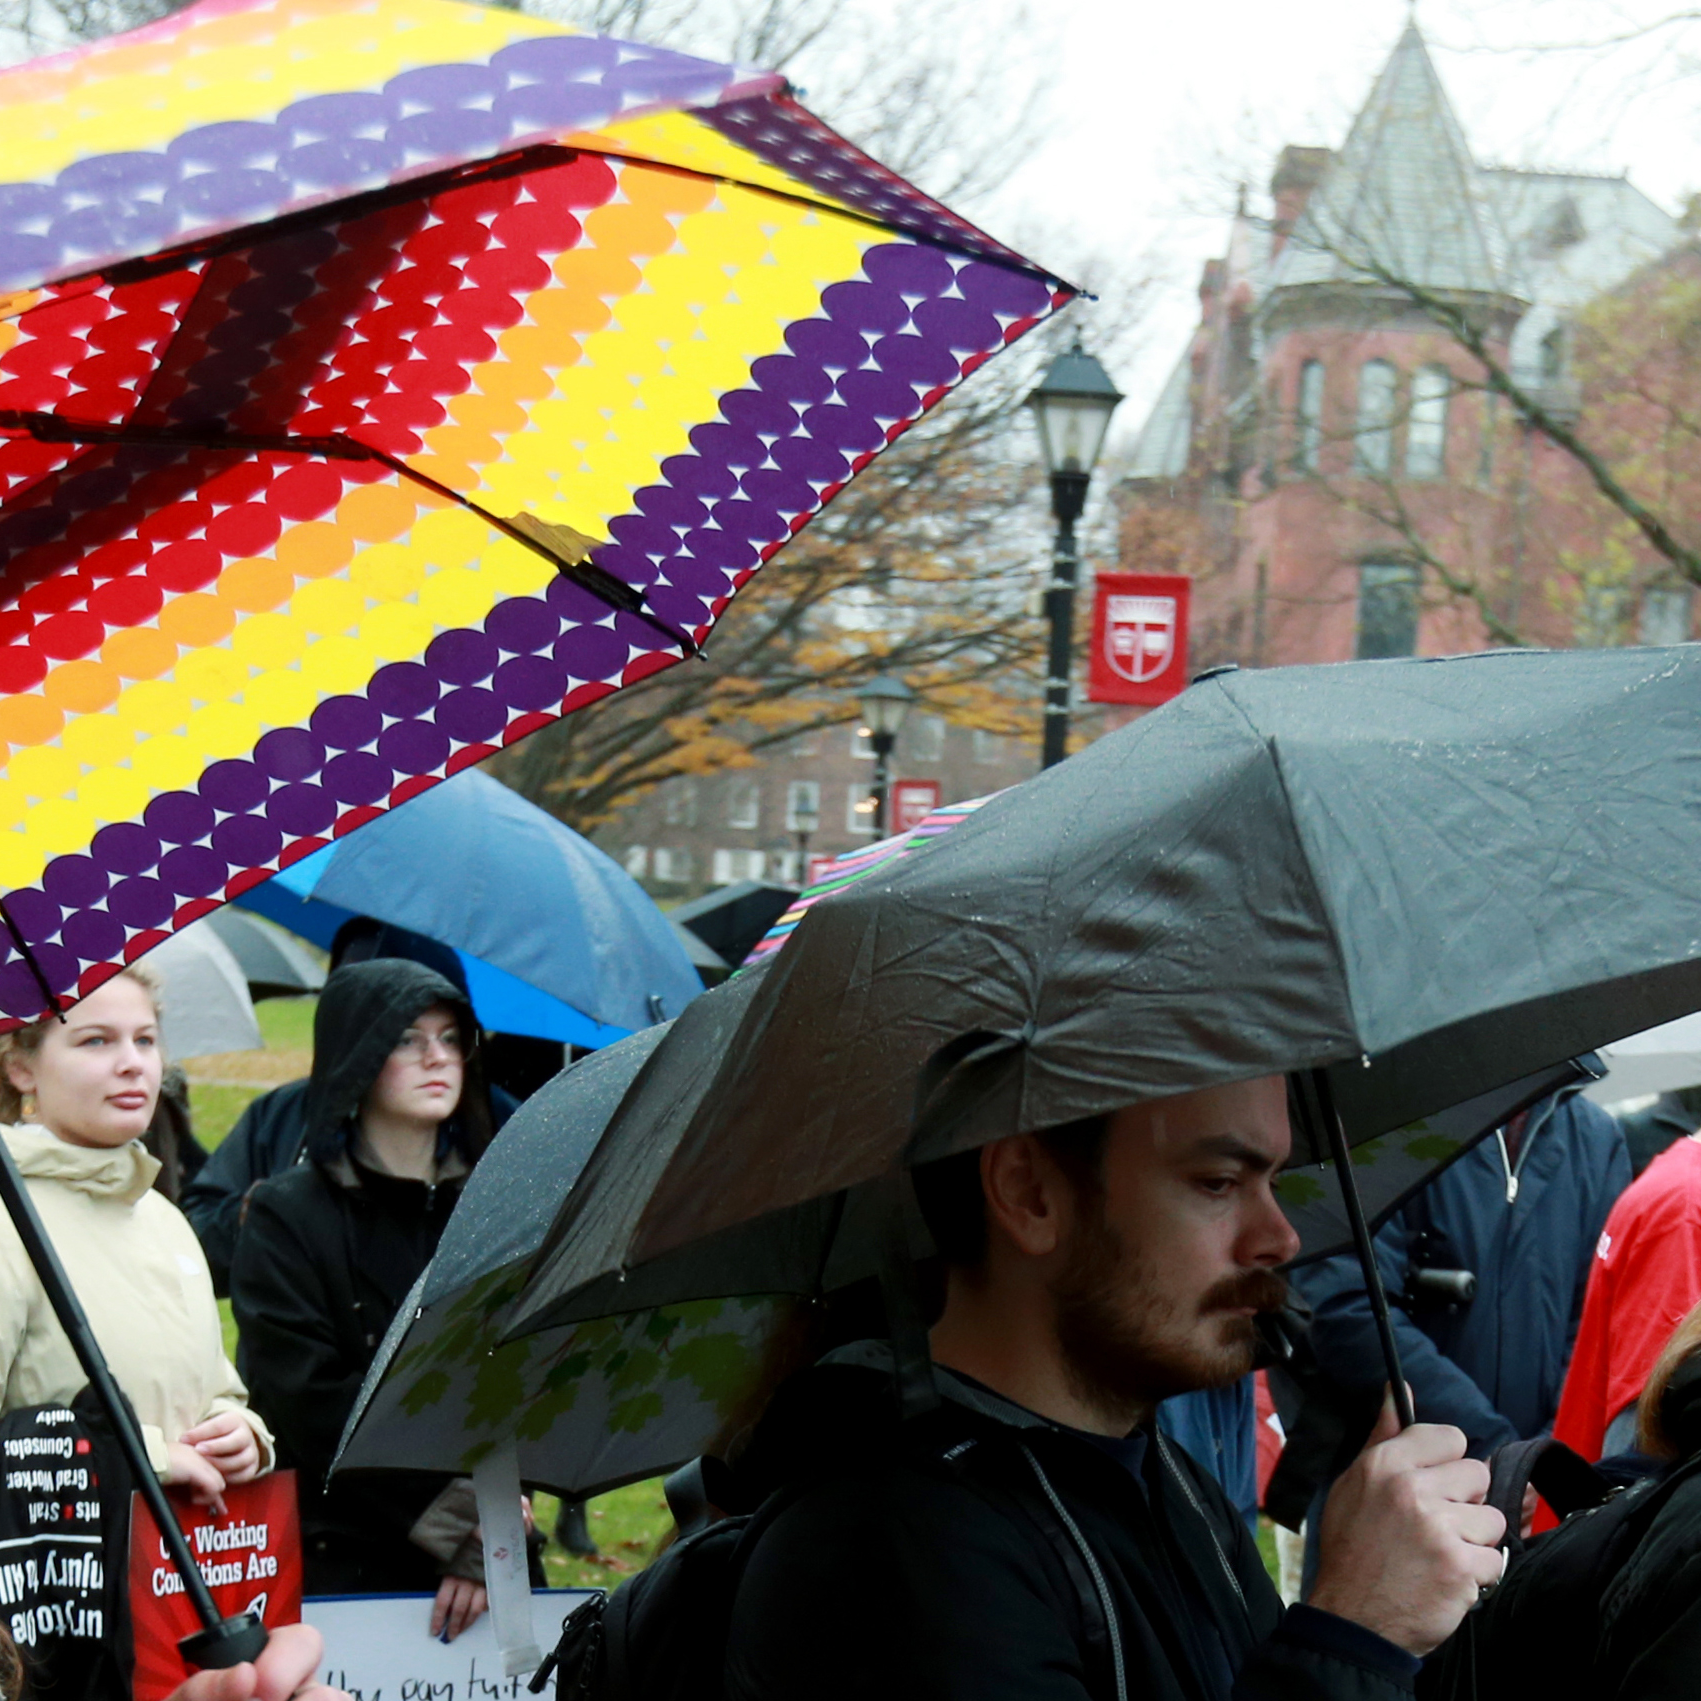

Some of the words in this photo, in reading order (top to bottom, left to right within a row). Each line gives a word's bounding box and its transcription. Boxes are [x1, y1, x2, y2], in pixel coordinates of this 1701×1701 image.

[56, 1468, 89, 1491] Grad
[194, 1520, 268, 1554] Working
[152, 1558, 243, 1597] Contions
[245, 1552, 278, 1580] Are
